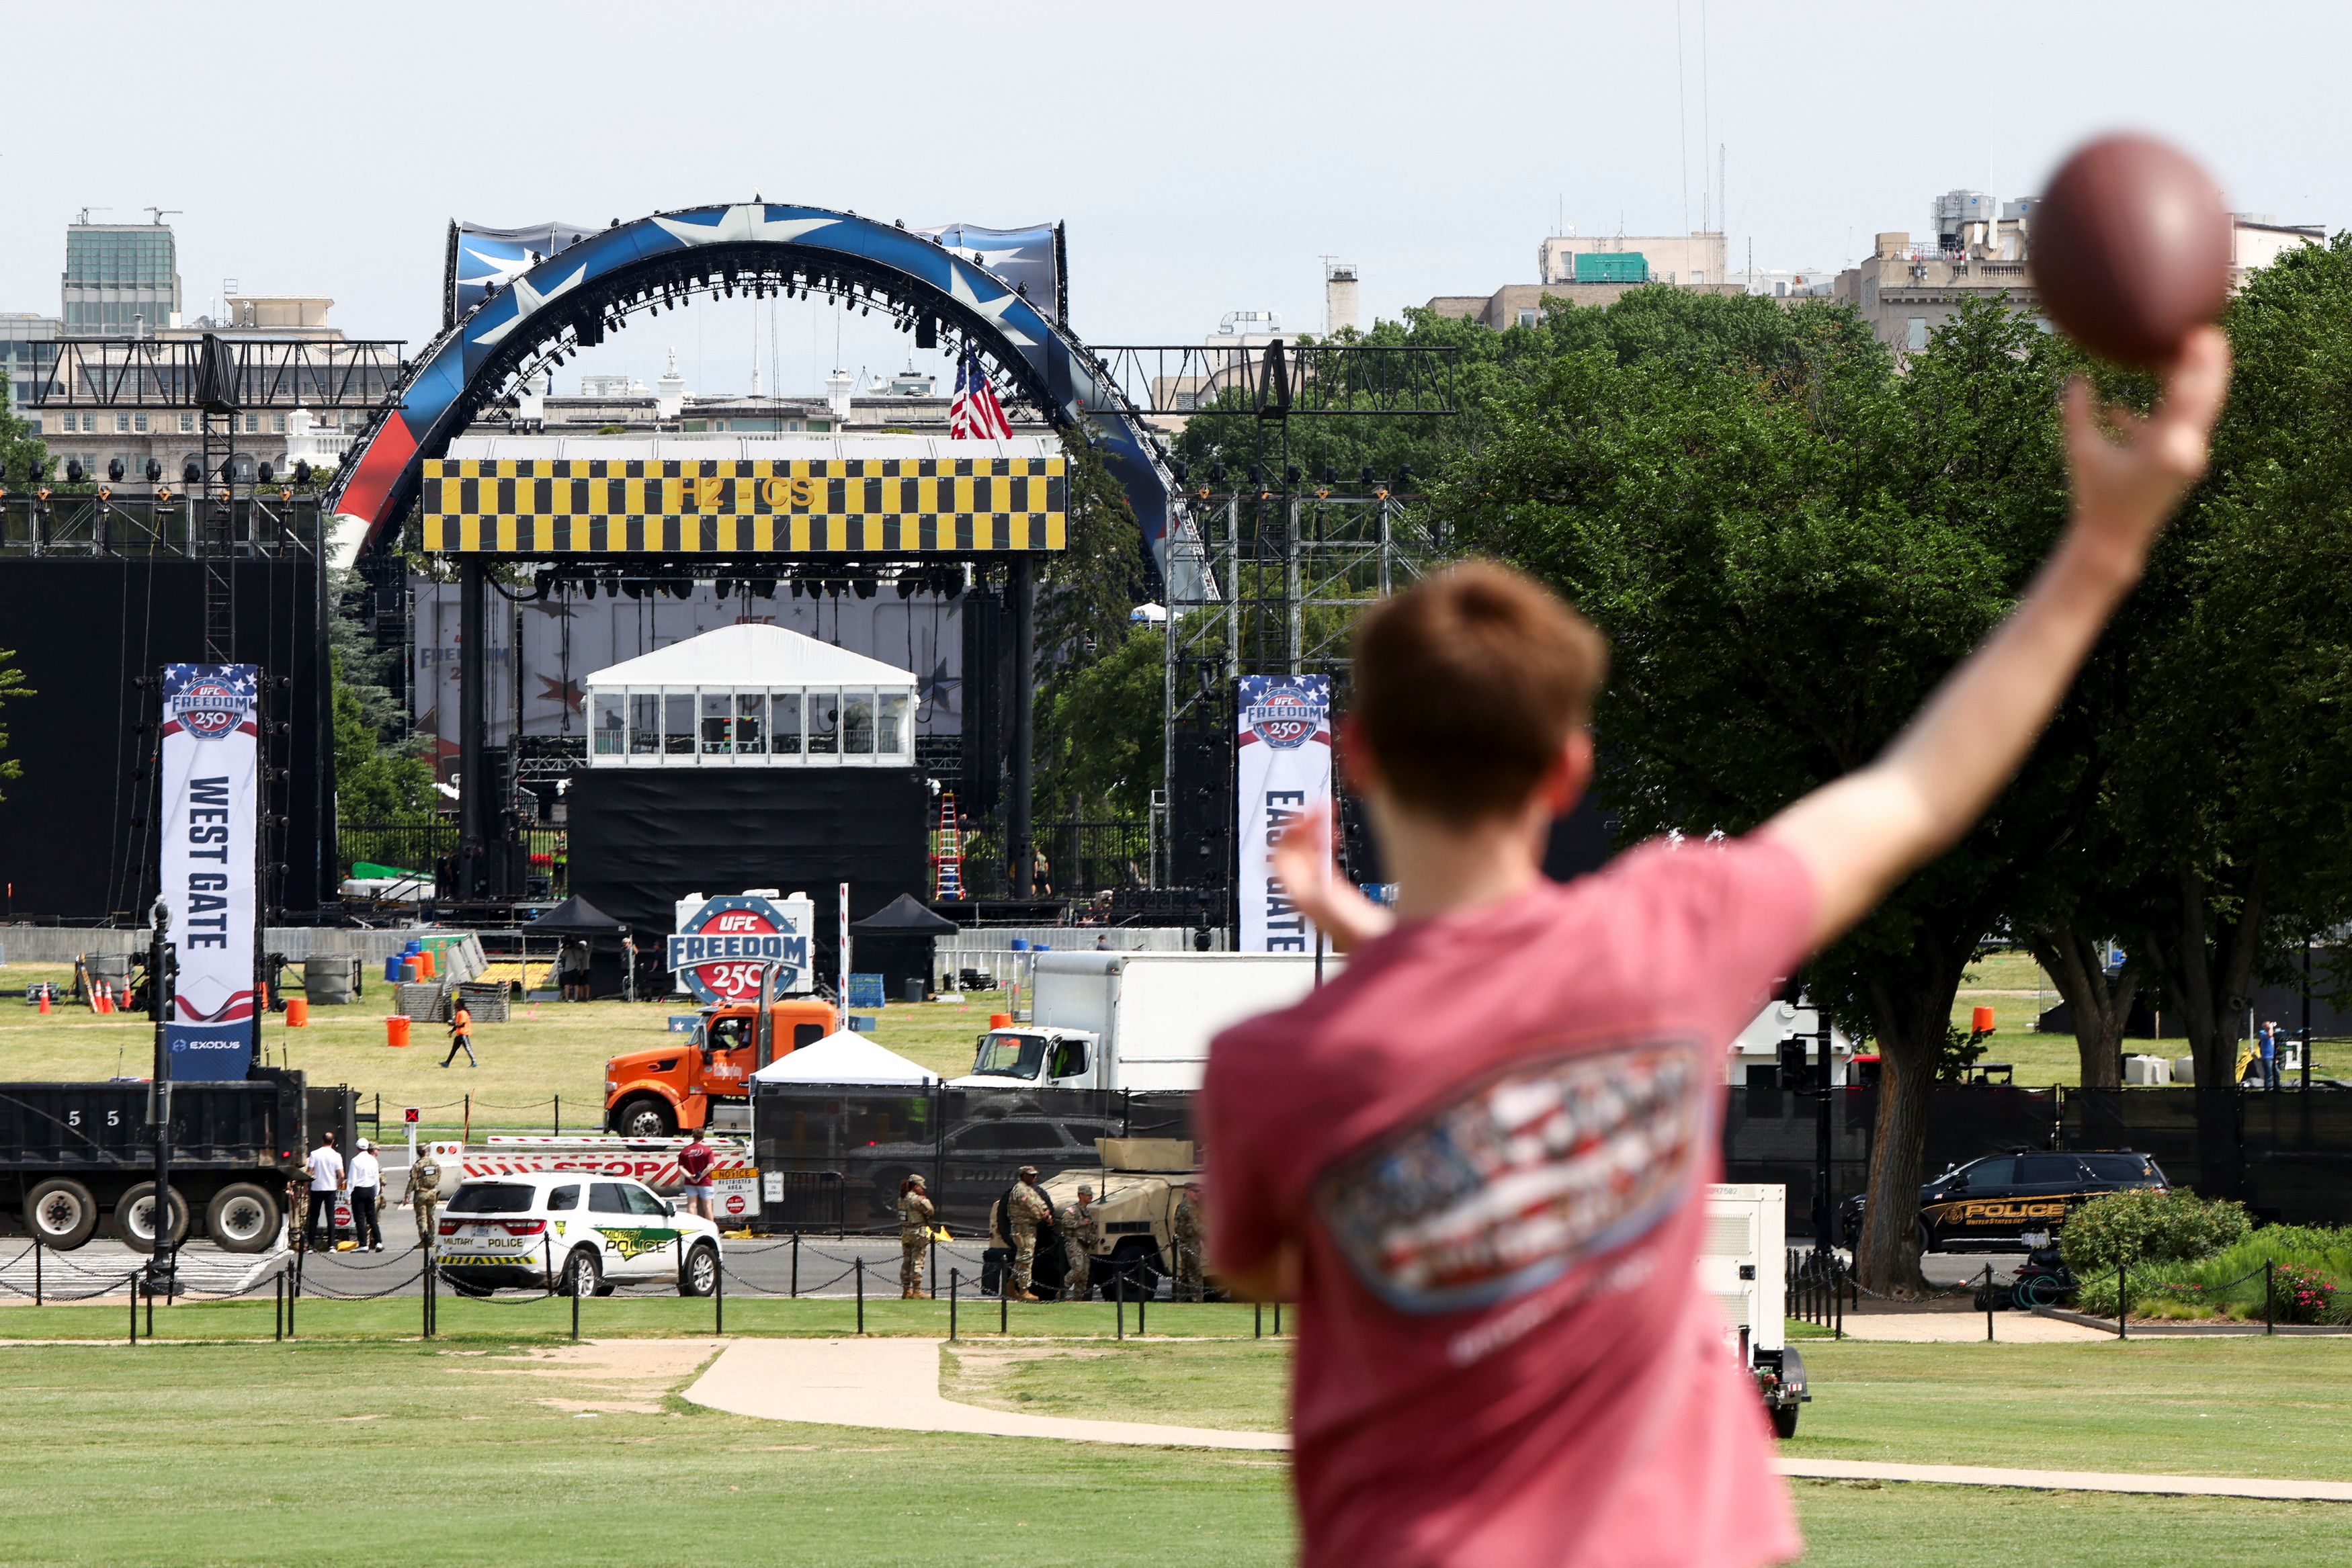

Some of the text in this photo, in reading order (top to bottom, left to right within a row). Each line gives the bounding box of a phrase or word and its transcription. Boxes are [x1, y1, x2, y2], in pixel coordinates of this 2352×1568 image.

[677, 476, 724, 507] H2
[761, 476, 814, 507] CS
[199, 687, 221, 695] UFC
[172, 696, 248, 713] FREEDOM
[195, 711, 226, 729] 250
[1247, 706, 1322, 723] FREEDOM
[1270, 722, 1302, 739] 250
[187, 776, 229, 950] WEST GATE
[718, 916, 758, 931] UFC
[669, 936, 806, 970] FREEDOM
[190, 1041, 241, 1049] EXODUS
[69, 1110, 120, 1126] 5 5
[554, 1162, 661, 1177] STOP
[718, 1170, 751, 1178] NOTICE
[1964, 1203, 2066, 1217] POLICE
[444, 1237, 523, 1248] MILITARY POLICE
[603, 1230, 642, 1240] MILITARY
[605, 1239, 667, 1253] POLICE
